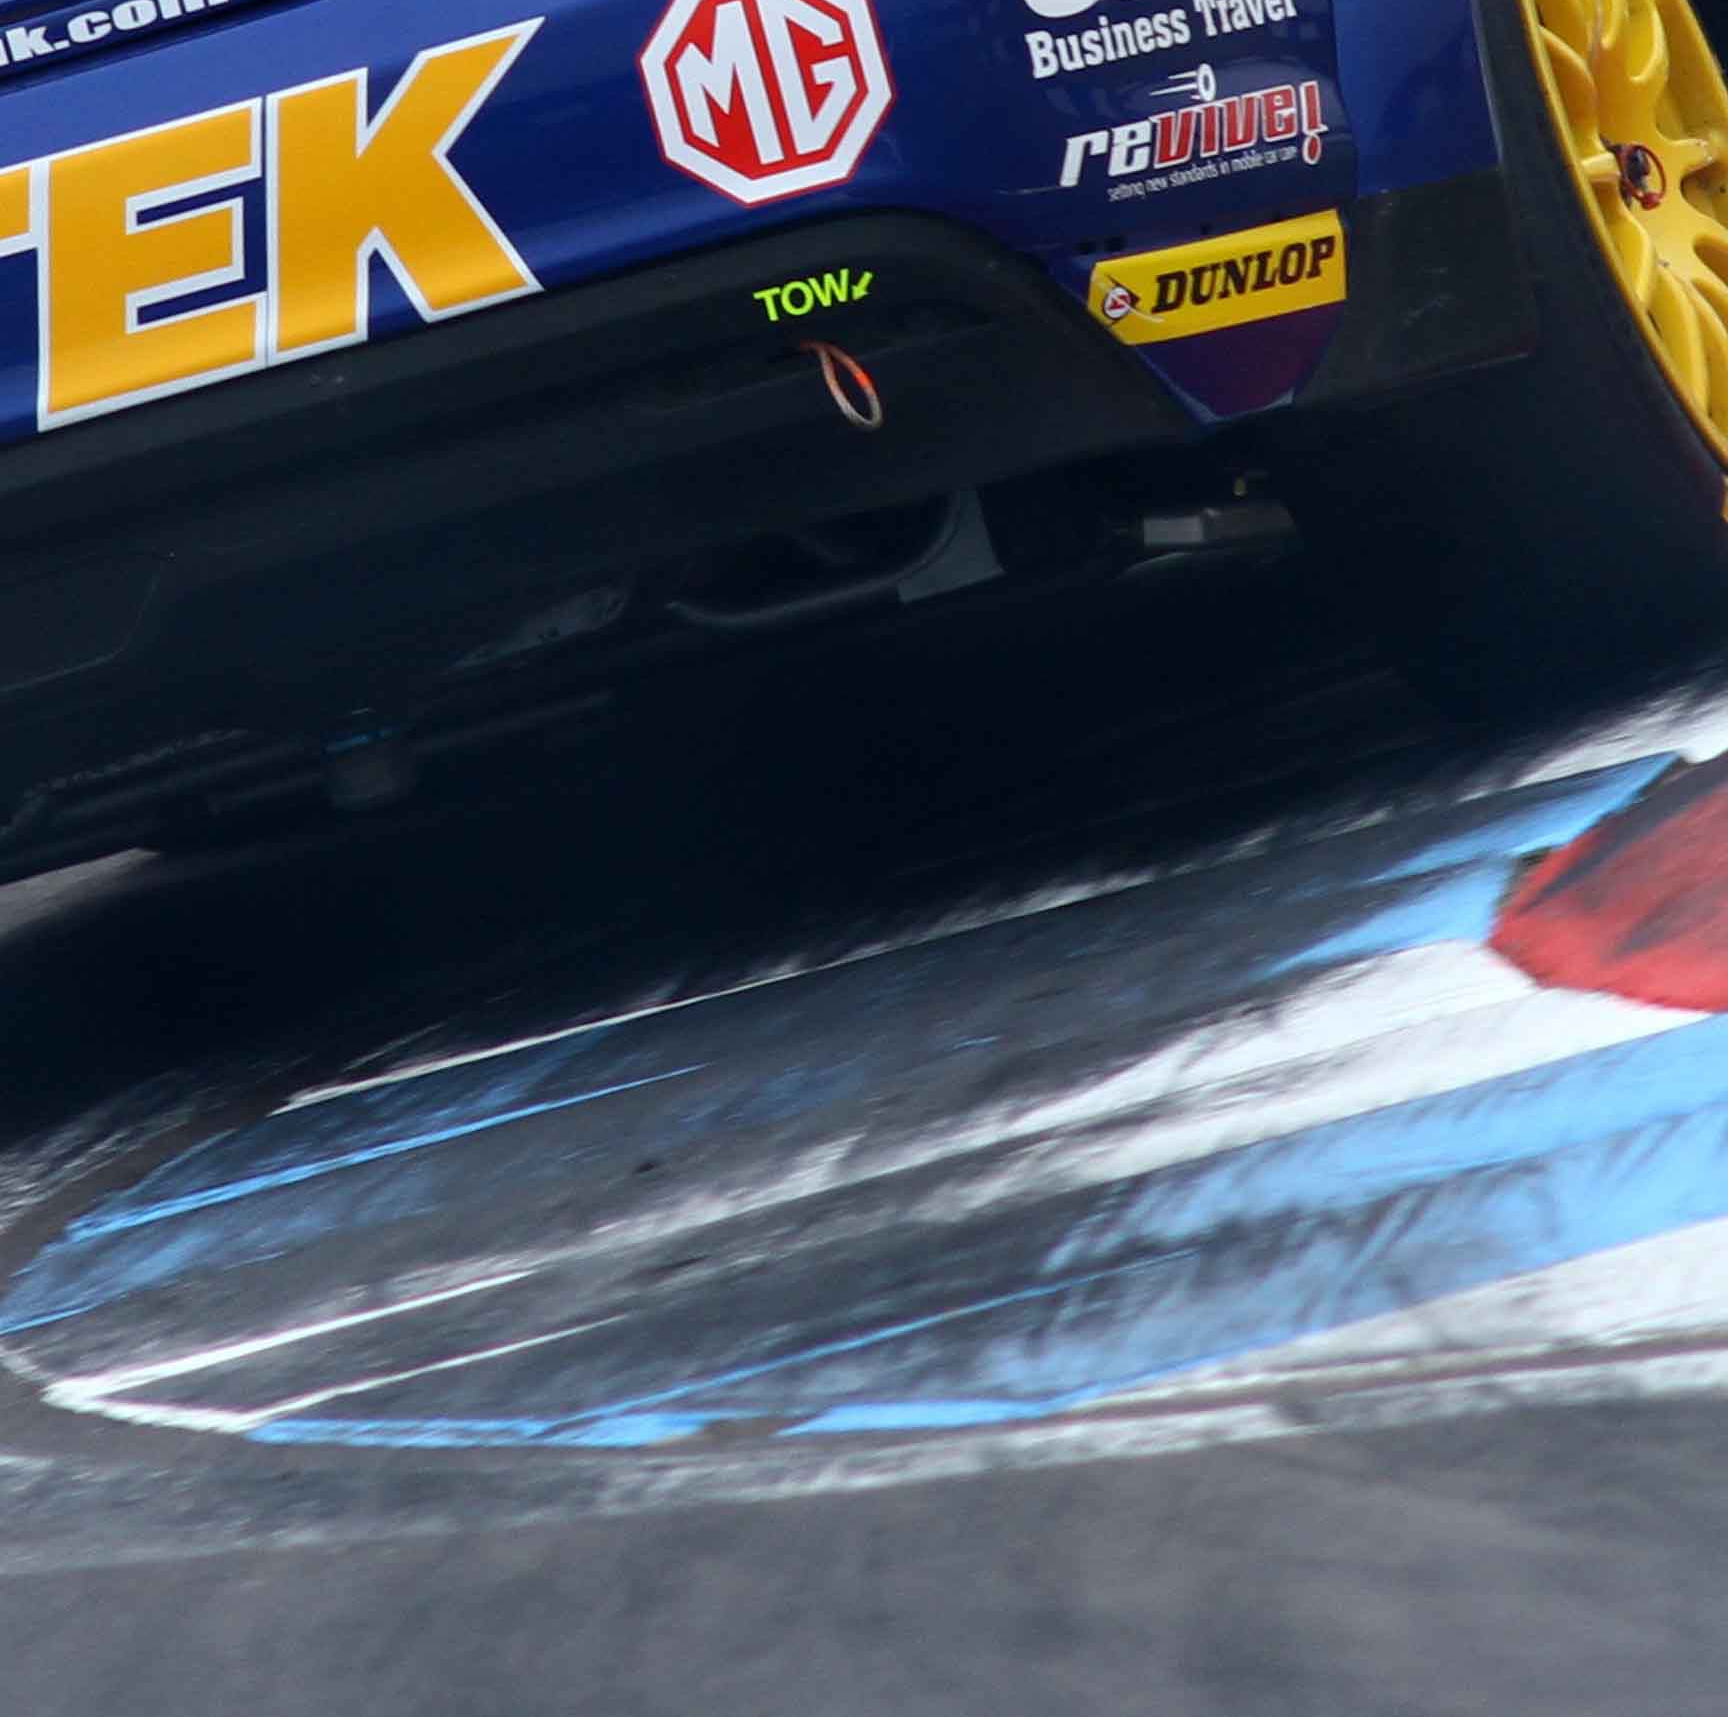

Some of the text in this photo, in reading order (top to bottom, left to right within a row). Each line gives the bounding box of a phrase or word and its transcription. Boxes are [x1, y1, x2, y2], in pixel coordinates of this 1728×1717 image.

[1025, 14, 1191, 80] Business
[753, 268, 855, 324] TOW
[1152, 235, 1335, 314] DUNLOP
